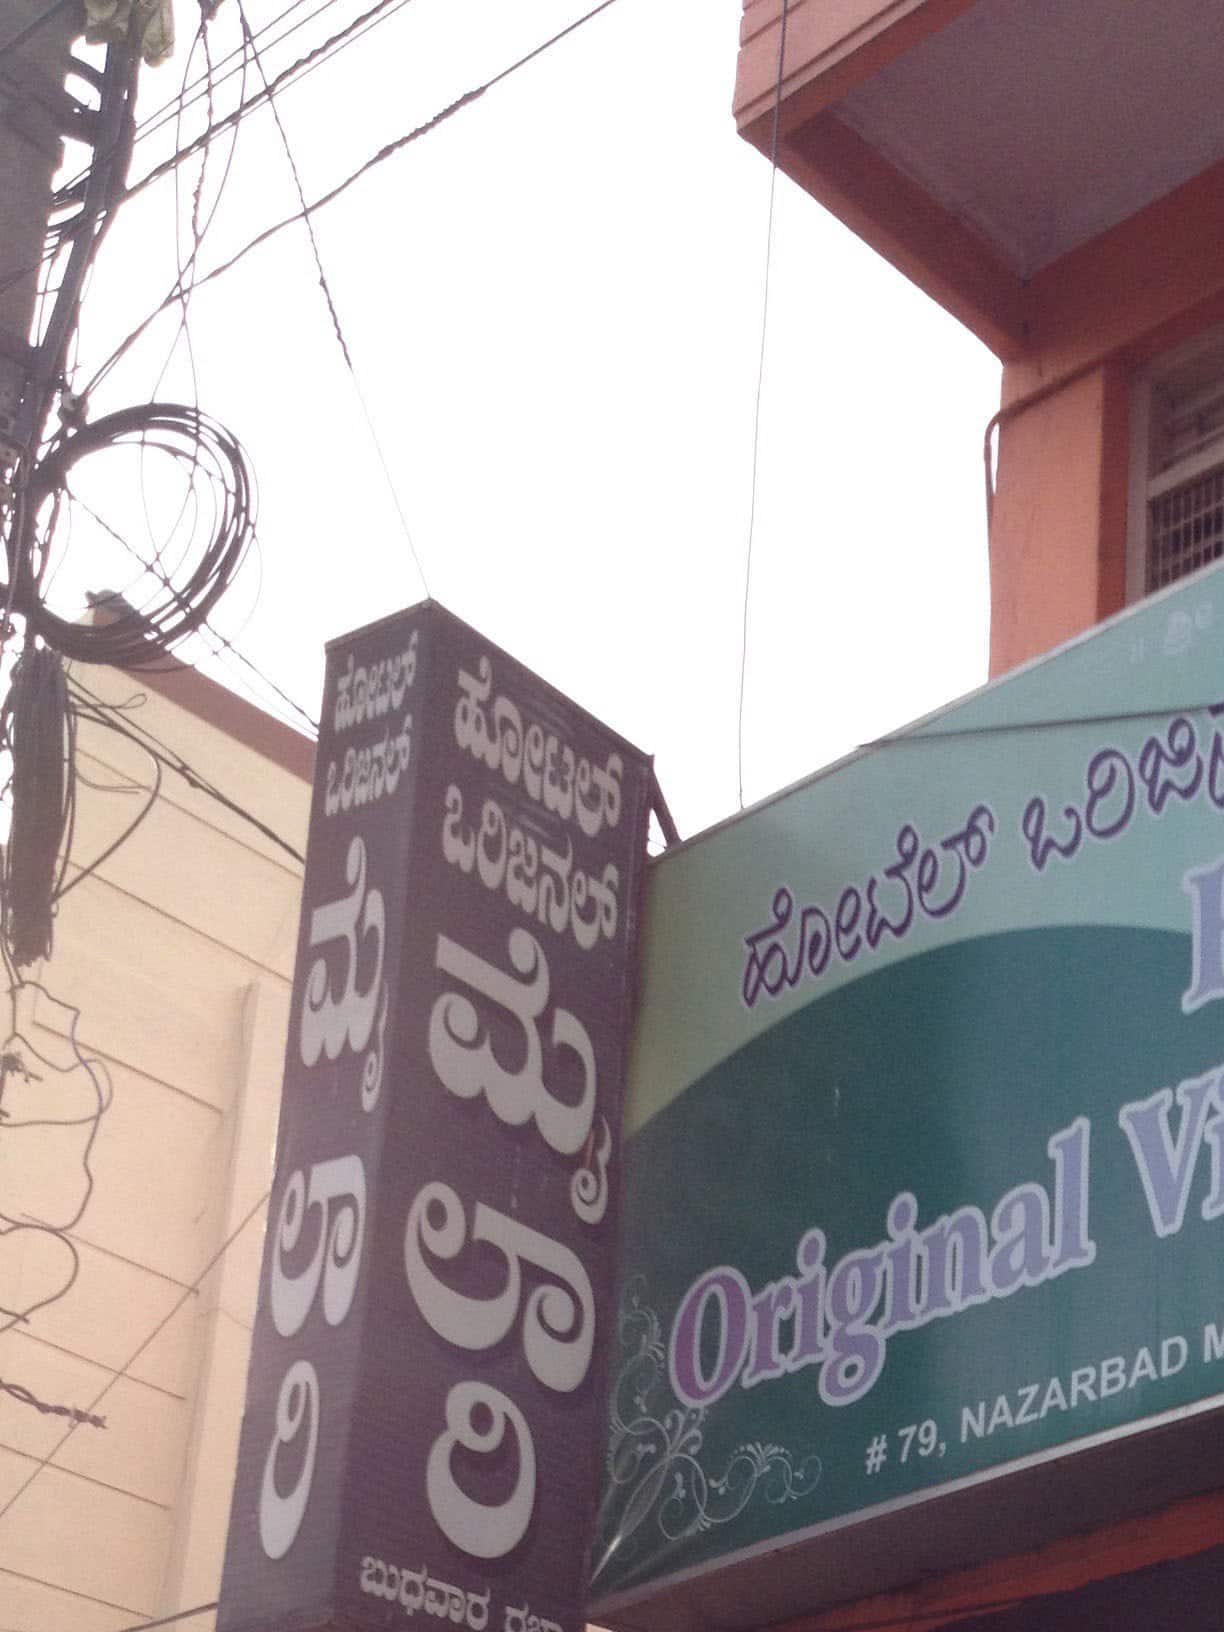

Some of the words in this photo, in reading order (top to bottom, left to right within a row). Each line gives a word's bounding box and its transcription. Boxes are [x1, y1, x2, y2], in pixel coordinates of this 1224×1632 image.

[668, 1116, 1096, 1408] Original
[897, 1419, 947, 1464] 79,
[959, 1335, 1190, 1444] NAZARBAD
[360, 1556, 491, 1631] ಬುಧವಾರ
